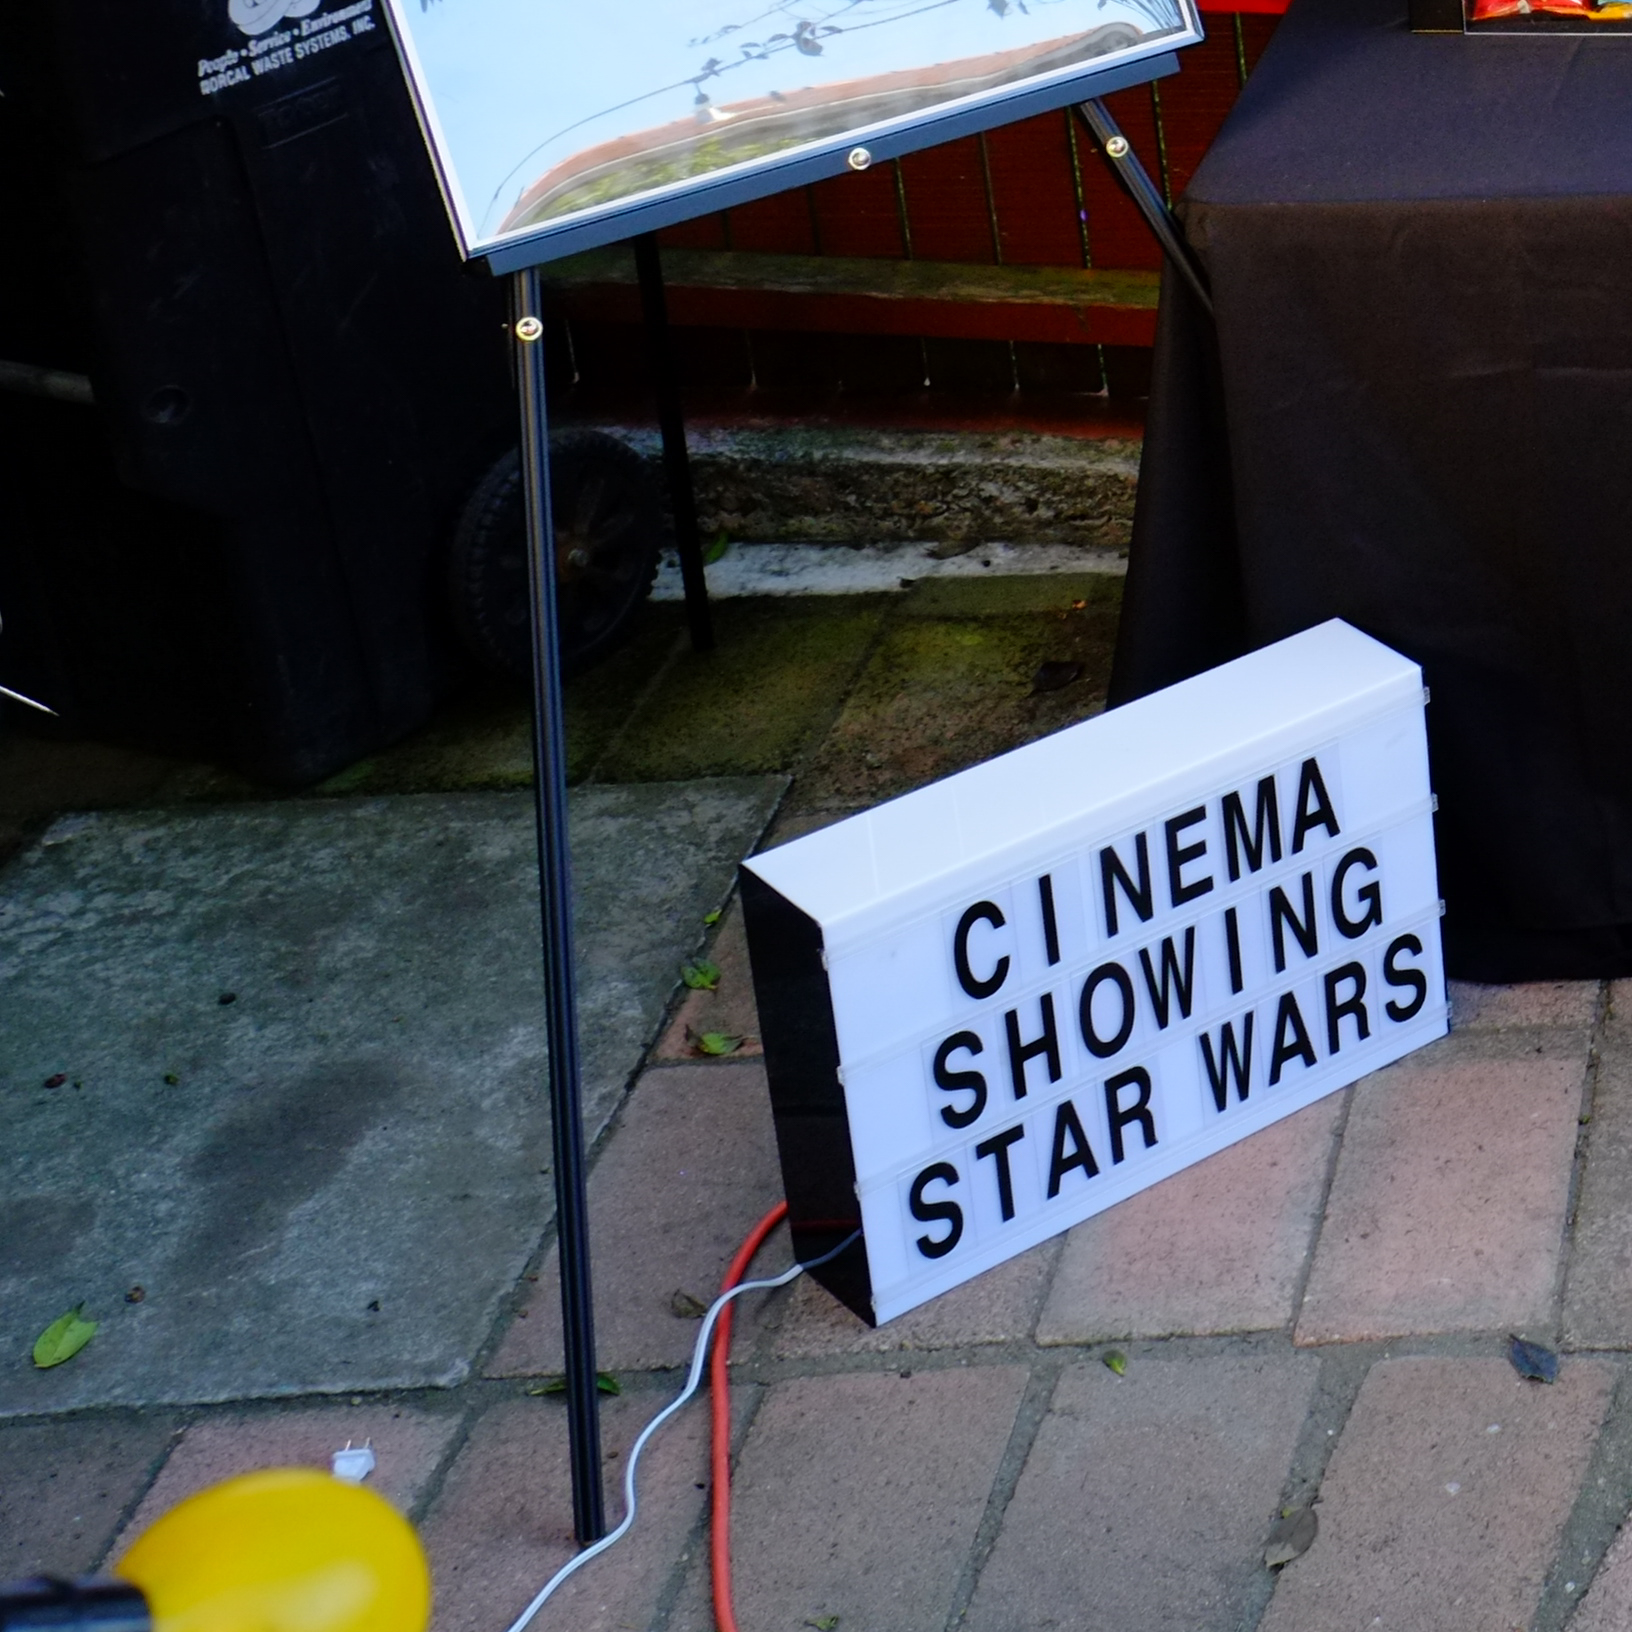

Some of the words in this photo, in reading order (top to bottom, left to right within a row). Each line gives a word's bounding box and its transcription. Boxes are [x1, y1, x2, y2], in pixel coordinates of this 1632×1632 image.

[197, 49, 240, 77] People
[248, 30, 292, 57] Service
[251, 47, 294, 76] WASTE
[931, 846, 1383, 1129] SHOWING
[953, 757, 1342, 1000] CINEMA
[908, 1065, 1159, 1260] STAR
[1199, 933, 1428, 1113] WARS
